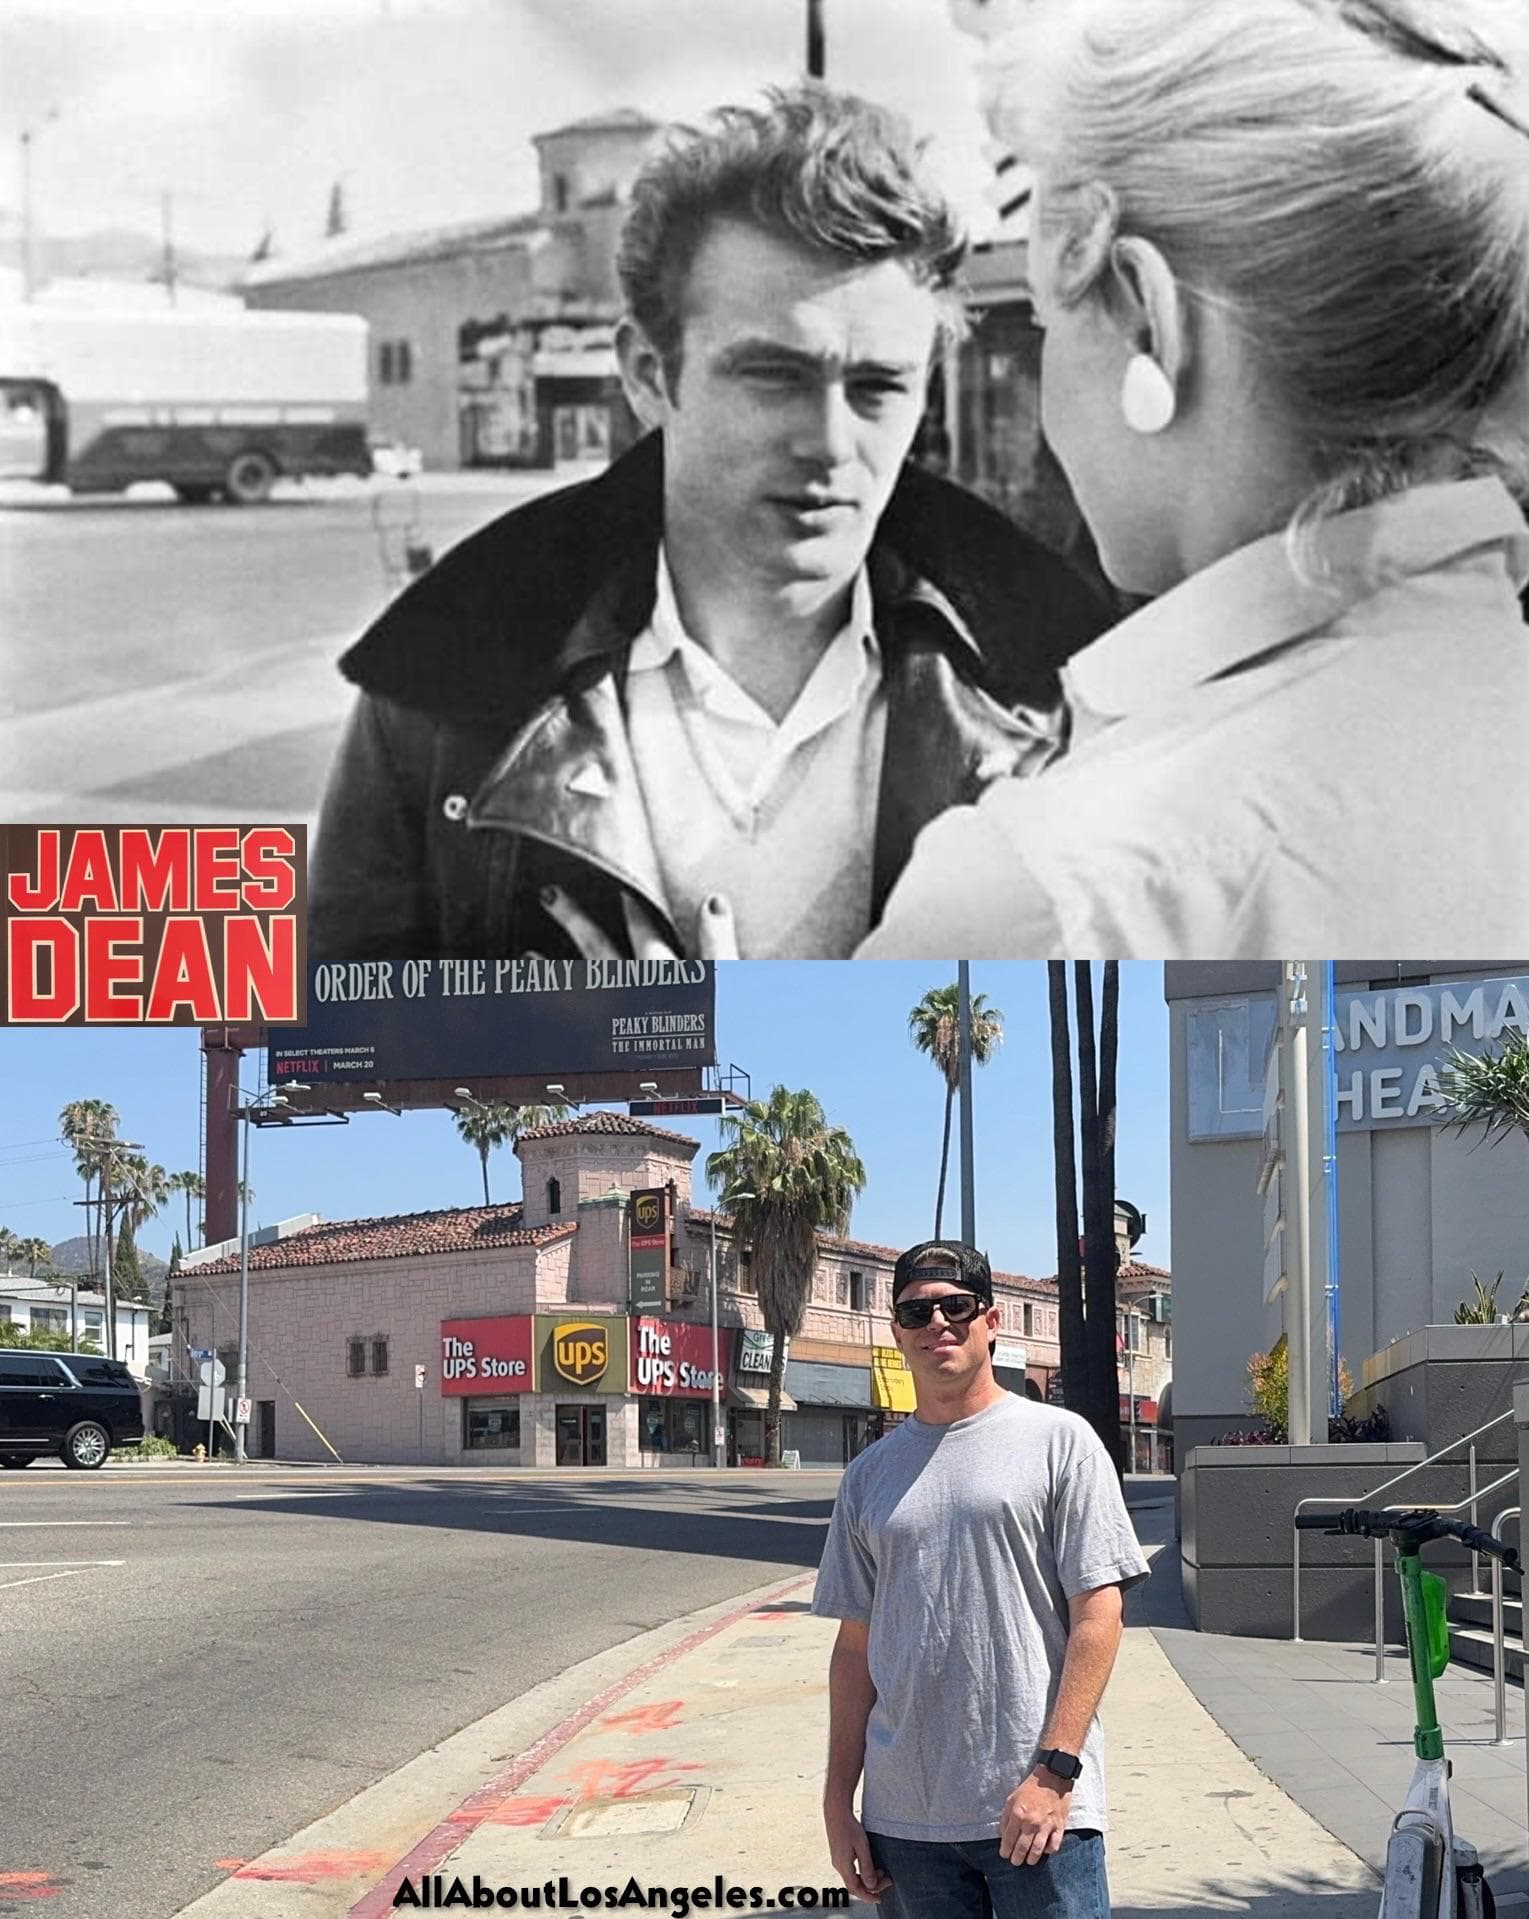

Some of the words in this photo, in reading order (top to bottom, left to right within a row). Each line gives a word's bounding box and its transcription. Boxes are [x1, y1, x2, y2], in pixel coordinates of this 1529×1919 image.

[315, 962, 394, 1002] ORDER
[402, 960, 431, 998] OF
[439, 960, 486, 996] THE
[494, 960, 574, 994] PEAKY
[585, 960, 706, 989] BLINDERS
[612, 1017, 649, 1035] PEAKY
[652, 1014, 705, 1033] BLINDERS
[1334, 984, 1529, 1052] NDMA
[284, 1049, 308, 1057] SELECT
[310, 1047, 343, 1056] THEATERS
[612, 1041, 630, 1053] THE
[634, 1039, 682, 1052] IMMORTAL
[686, 1037, 705, 1049] MAN
[276, 1060, 319, 1074] NETFLIX
[333, 1062, 362, 1070] MARCH
[363, 1060, 374, 1069] 20
[1334, 1064, 1466, 1121] HEA
[655, 1101, 699, 1113] NETFLIX
[638, 1206, 657, 1223] ups
[442, 1337, 473, 1357] The
[638, 1325, 672, 1355] The
[443, 1358, 477, 1379] UPS
[481, 1357, 526, 1378] Store
[559, 1342, 605, 1374] ups
[742, 1352, 786, 1370] CLEANS
[638, 1358, 675, 1387] UPS
[680, 1362, 724, 1390] Store
